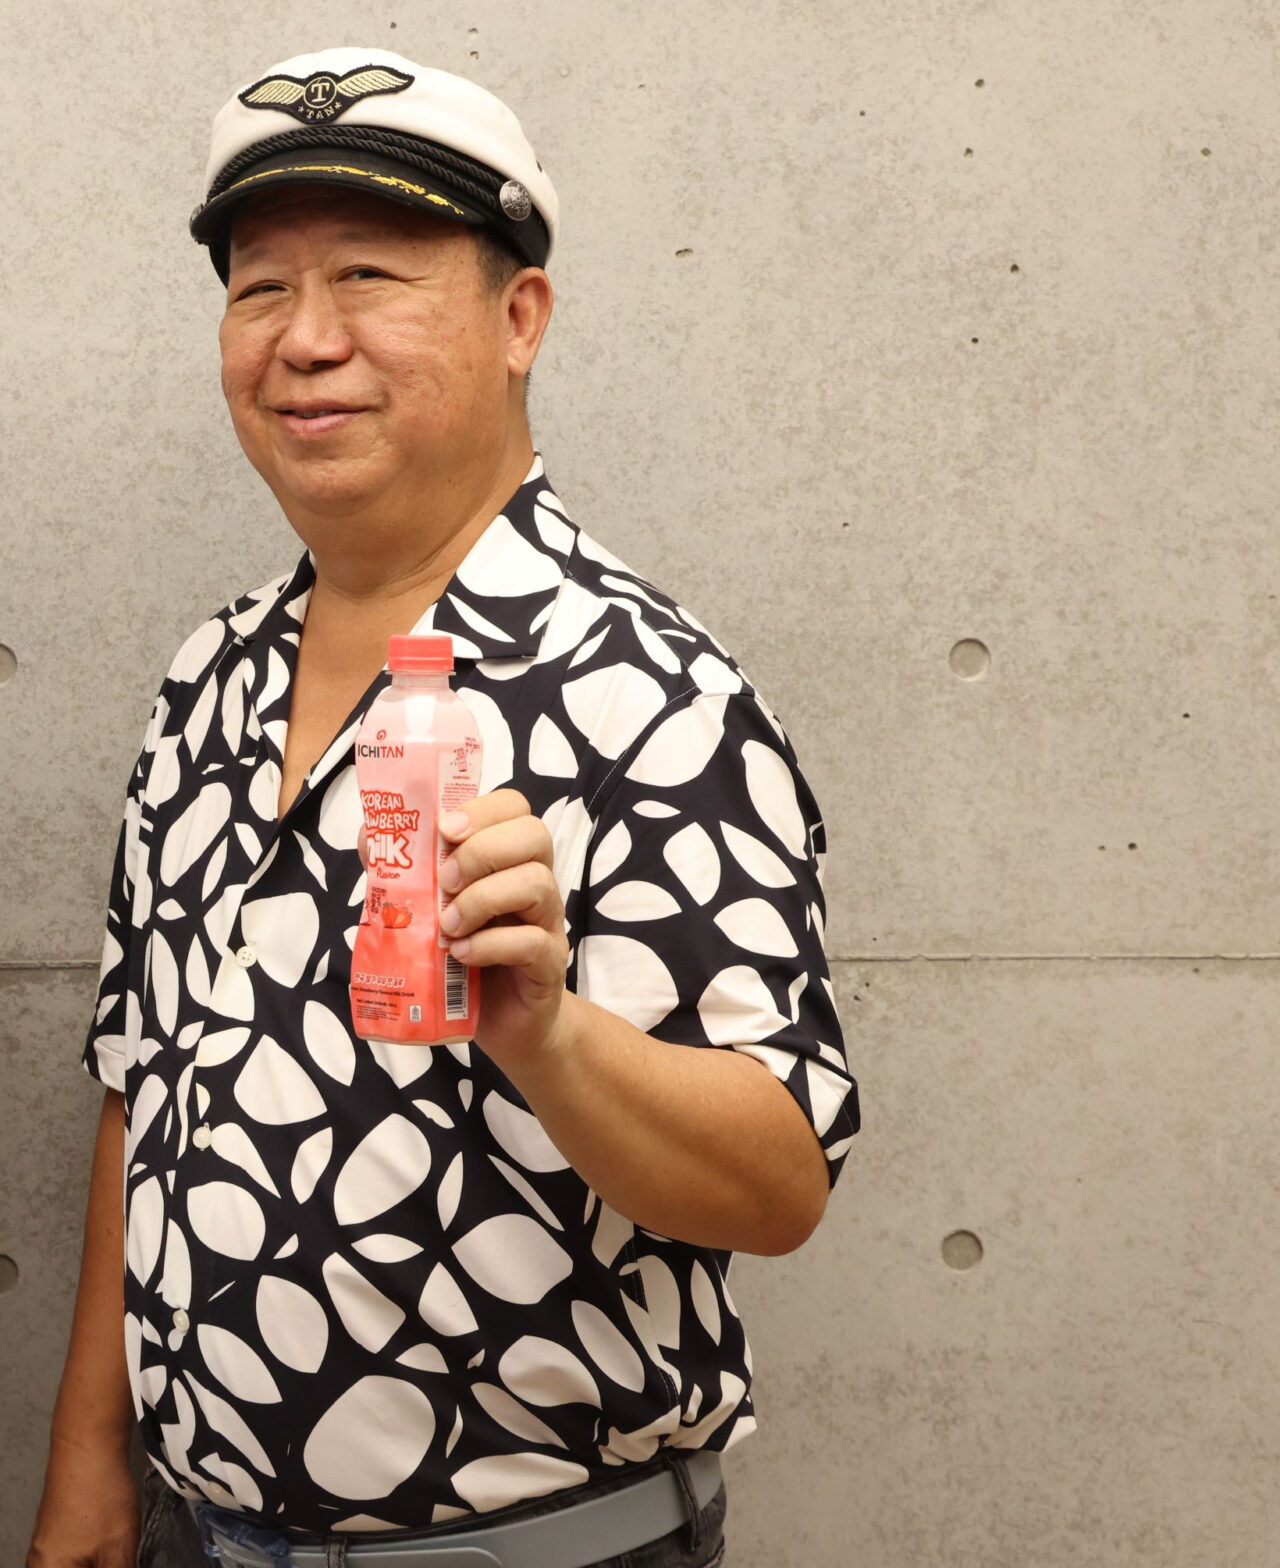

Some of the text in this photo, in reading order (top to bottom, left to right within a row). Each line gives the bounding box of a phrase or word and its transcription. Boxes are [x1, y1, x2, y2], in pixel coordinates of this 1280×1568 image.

[311, 82, 330, 102] T
[306, 105, 335, 120] TAN
[357, 744, 404, 759] ICHITAN
[361, 791, 403, 811] KOREAN
